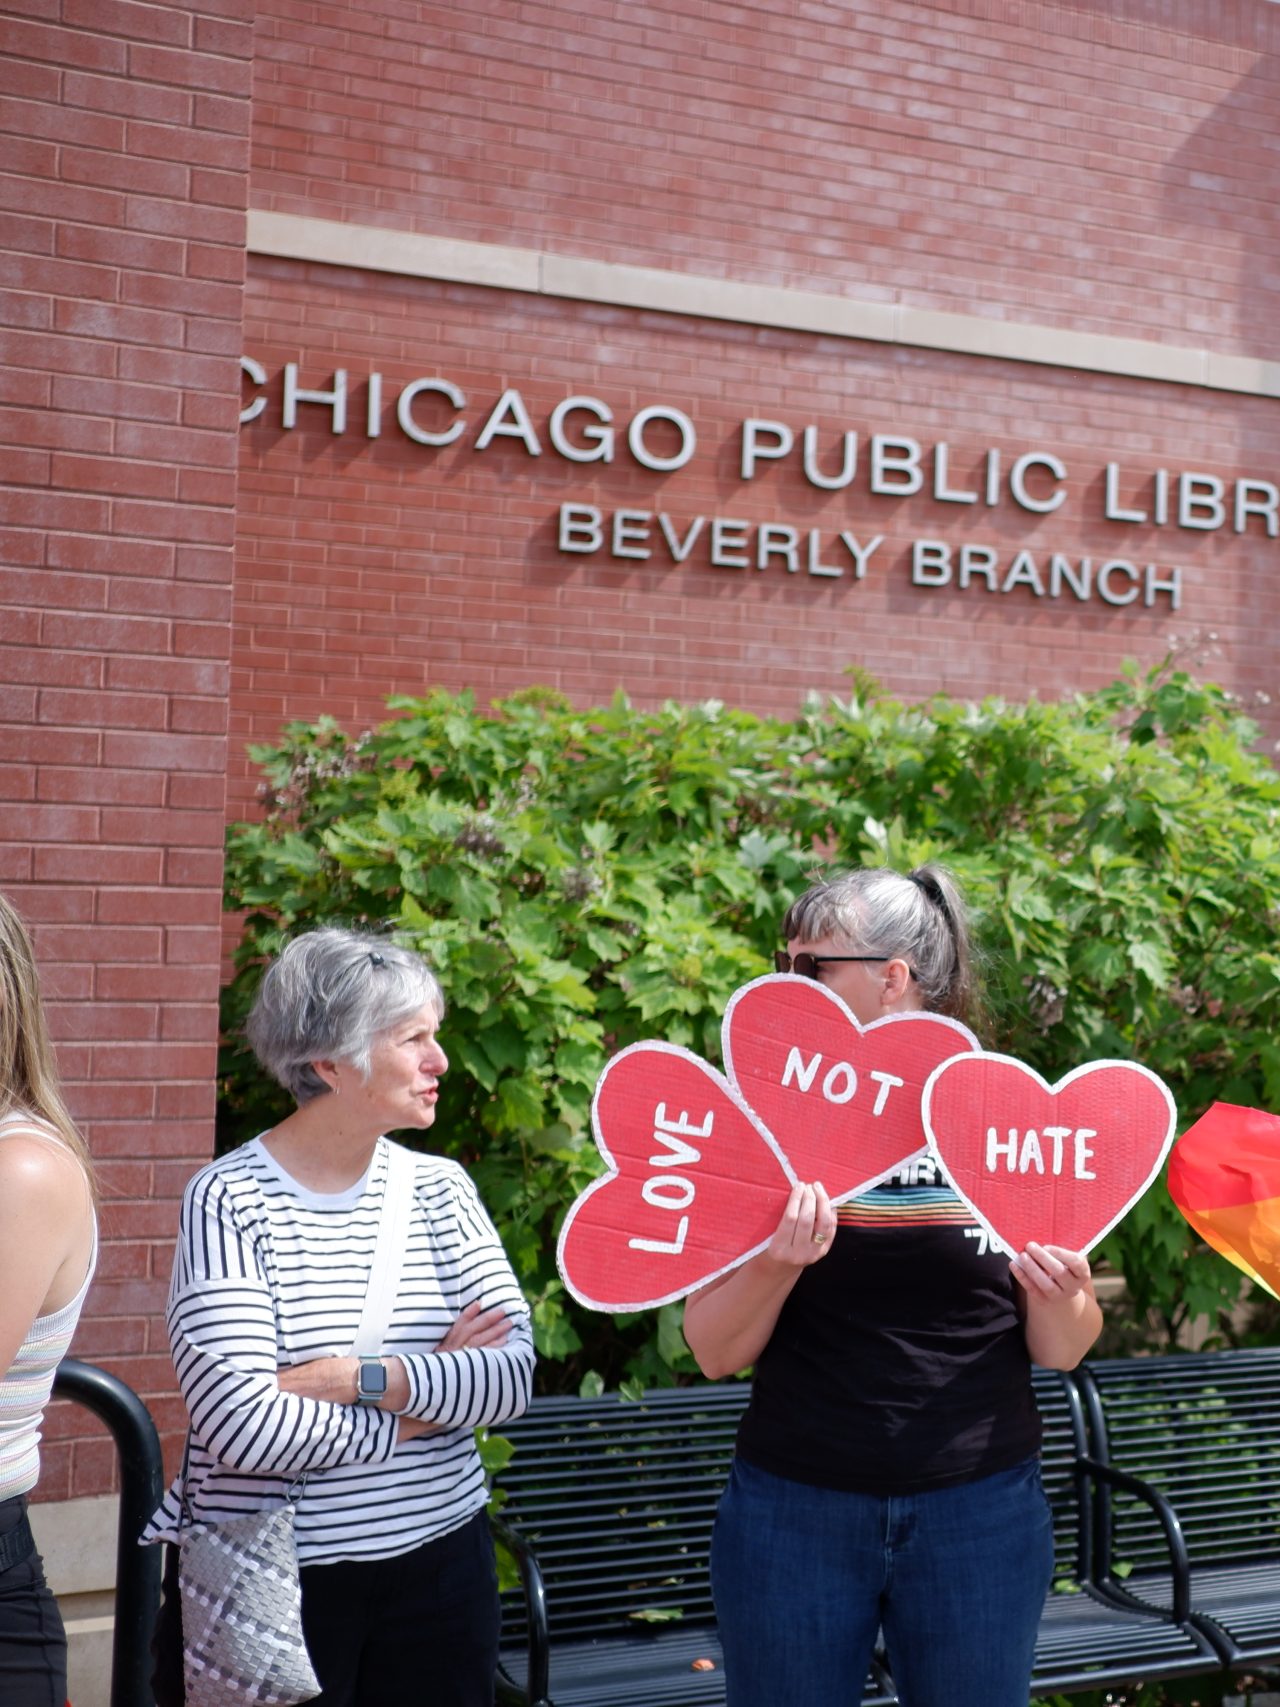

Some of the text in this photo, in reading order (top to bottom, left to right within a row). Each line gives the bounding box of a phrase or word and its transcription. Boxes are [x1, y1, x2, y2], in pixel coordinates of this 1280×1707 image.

[740, 416, 1067, 513] PUBLIC
[557, 501, 1184, 610] BEVERLY BRANCH
[780, 1046, 904, 1117] NOT
[628, 1101, 715, 1255] LOVE
[984, 1125, 1098, 1181] HATE
